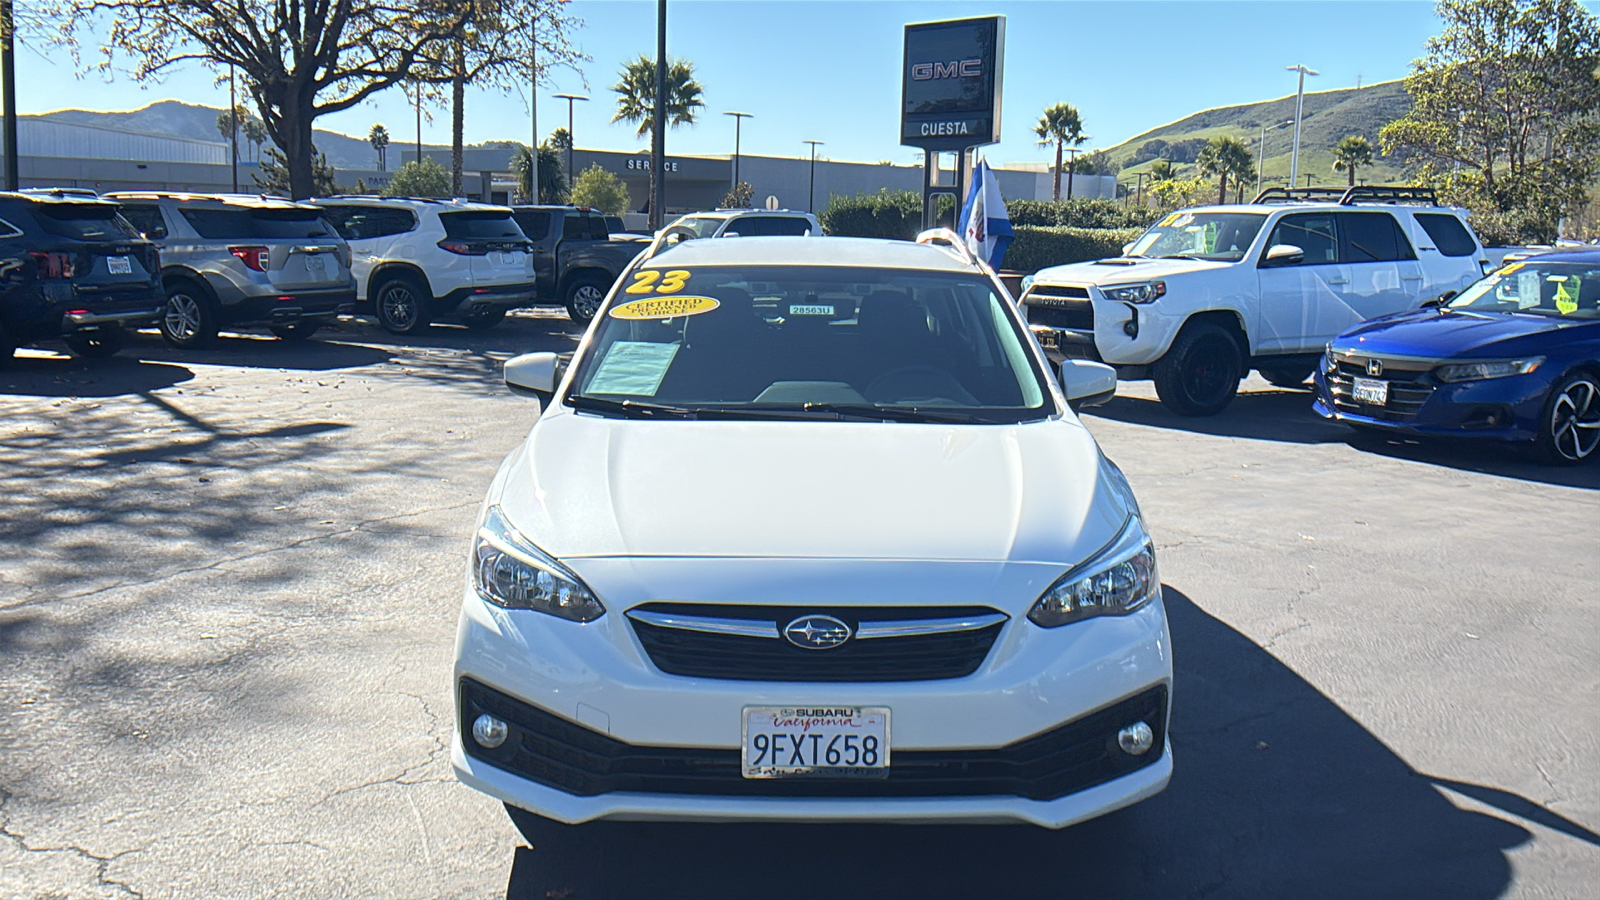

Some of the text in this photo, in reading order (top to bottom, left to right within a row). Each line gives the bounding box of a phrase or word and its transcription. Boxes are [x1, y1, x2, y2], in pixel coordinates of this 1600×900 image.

[912, 59, 982, 80] GMC
[921, 122, 968, 136] CUESTA
[628, 160, 678, 173] SERCE
[625, 270, 692, 294] 23
[626, 298, 703, 310] CERTIFIED
[1041, 297, 1066, 306] TOYOTA
[631, 304, 697, 314] PRE-OWNED
[639, 308, 688, 317] VEHICLE
[793, 306, 830, 315] 28563U
[796, 708, 854, 717] SUBARU
[773, 717, 862, 732] California
[753, 733, 878, 766] 9FXT658
